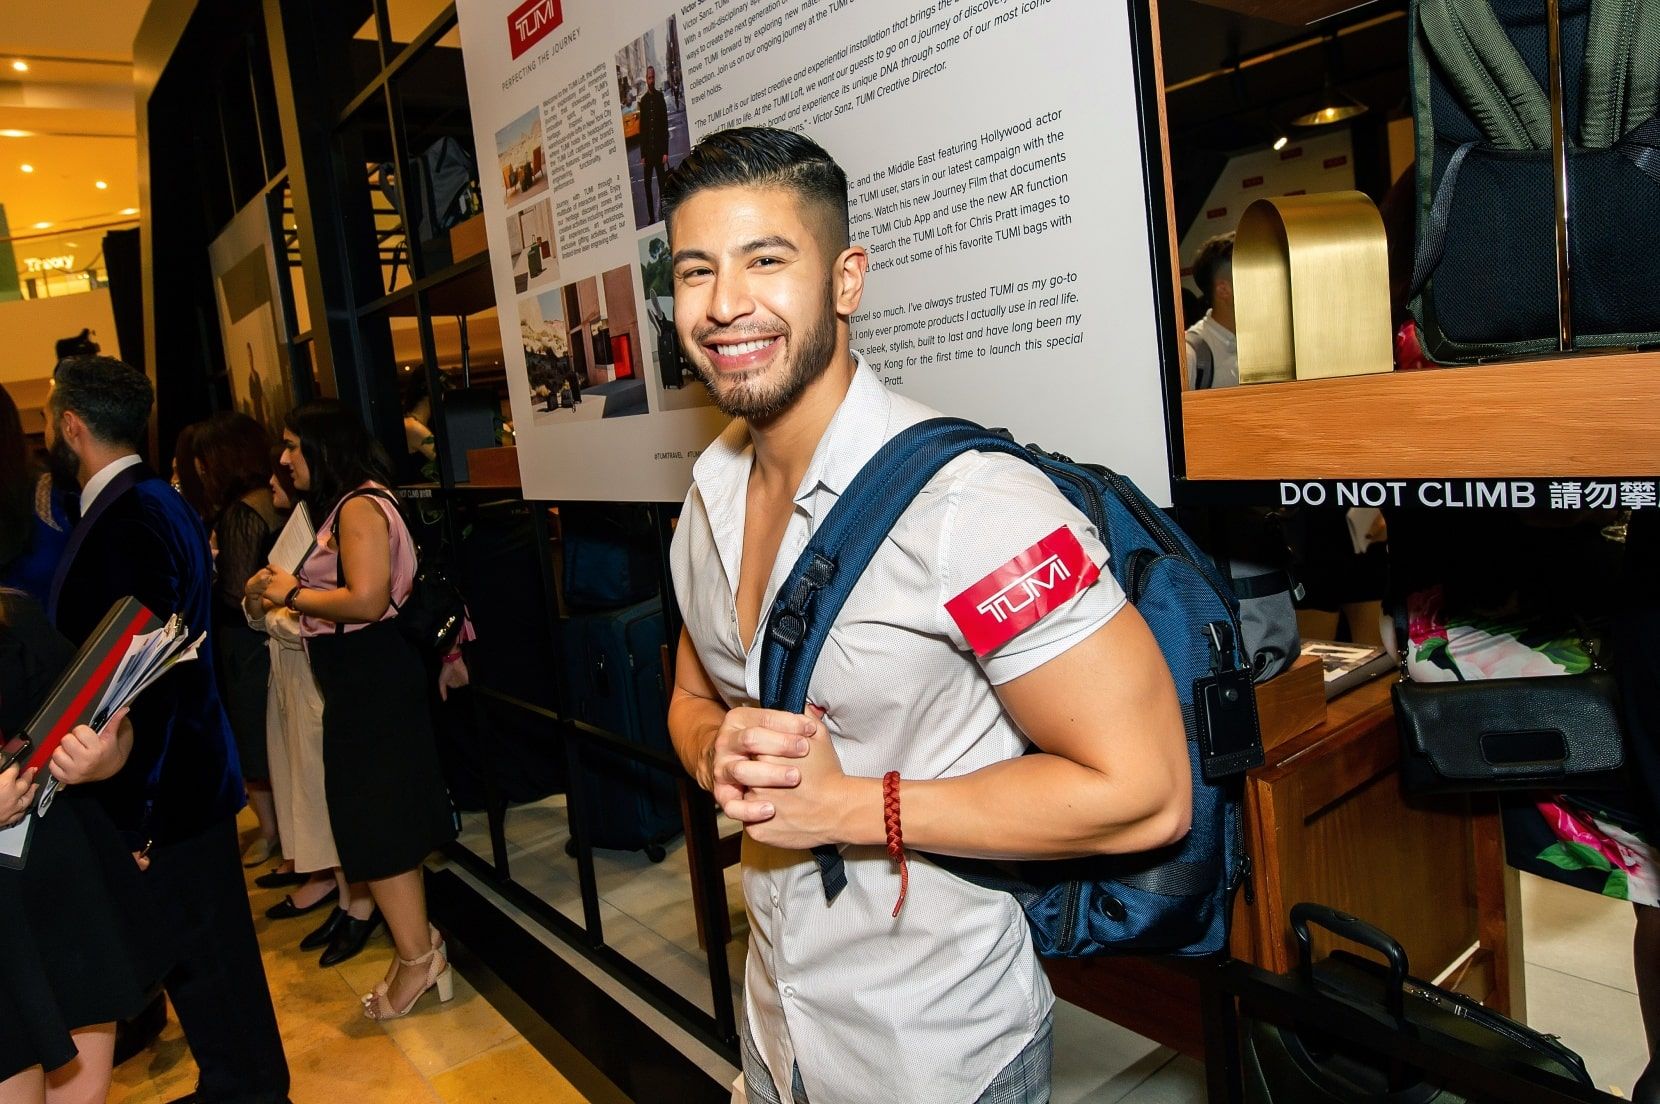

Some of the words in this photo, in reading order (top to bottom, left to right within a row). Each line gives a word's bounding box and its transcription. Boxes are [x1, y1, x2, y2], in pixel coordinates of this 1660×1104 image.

[515, 0, 554, 41] TUMI
[807, 45, 848, 74] experiential
[849, 27, 890, 54] installation
[891, 16, 908, 33] that
[909, 4, 936, 24] brings
[815, 9, 827, 21] the
[501, 60, 537, 91] PERFECTING
[538, 50, 550, 66] THE
[551, 26, 581, 56] JOURNEY
[801, 89, 839, 112] experience
[852, 72, 877, 89] unique
[879, 60, 898, 77] DNA
[900, 45, 933, 68] through
[935, 34, 960, 52] some
[974, 19, 991, 34] our
[993, 6, 1018, 26] most
[817, 71, 834, 87] want
[835, 66, 848, 78] our
[849, 54, 874, 74] guests
[875, 50, 884, 60] to
[885, 44, 896, 59] go
[898, 38, 908, 49] on
[916, 17, 951, 44] journey
[952, 9, 962, 23] of
[812, 109, 832, 124] Victor
[833, 101, 854, 115] Sanz,
[855, 89, 875, 106] TUMI
[876, 76, 910, 97] Creative
[911, 60, 947, 82] Director.
[856, 173, 870, 187] and
[872, 170, 885, 181] the
[887, 159, 915, 176] Middle
[917, 151, 935, 166] East
[937, 139, 977, 159] featuring
[980, 117, 1032, 145] Hollywood
[1035, 109, 1062, 126] actor
[858, 188, 879, 203] TUMI
[880, 184, 900, 197] user,
[900, 177, 920, 190] stars
[921, 173, 929, 184] in
[931, 169, 946, 181] our
[947, 159, 973, 175] latest
[974, 144, 1020, 167] campaign
[1022, 135, 1044, 151] with
[1046, 131, 1064, 144] the
[857, 229, 869, 239] the
[870, 221, 891, 235] TUMI
[893, 216, 911, 229] Club
[913, 212, 930, 225] App
[932, 204, 949, 219] and
[951, 202, 967, 213] use
[969, 196, 984, 208] the
[986, 190, 1007, 204] new
[1009, 183, 1024, 197] AR
[1026, 173, 1068, 192] function
[873, 201, 898, 217] Watch
[899, 198, 911, 209] his
[912, 193, 930, 205] new
[931, 182, 966, 200] Journey
[968, 173, 987, 189] Film
[989, 168, 1008, 182] that
[1009, 152, 1066, 176] documents
[869, 238, 896, 254] Search
[897, 236, 911, 247] the
[912, 227, 934, 242] TUMI
[936, 223, 953, 237] Loft
[954, 221, 967, 232] for
[969, 213, 993, 228] Chris
[994, 206, 1018, 221] Pratt
[1019, 197, 1056, 215] images
[1058, 194, 1070, 204] to
[871, 257, 894, 271] check
[895, 253, 909, 265] out
[910, 249, 932, 262] some
[934, 244, 943, 256] of
[944, 242, 957, 254] his
[958, 234, 993, 250] favorite
[994, 225, 1020, 241] TUMI
[1022, 221, 1047, 235] bags
[1049, 213, 1071, 228] with
[850, 310, 870, 324] travel
[872, 310, 881, 319] so
[883, 304, 906, 318] much.
[908, 302, 922, 312] I've
[924, 296, 953, 309] always
[955, 287, 986, 304] trusted
[989, 282, 1014, 297] TUMI
[1016, 282, 1028, 292] as
[1031, 278, 1047, 290] my
[1049, 271, 1077, 288] go-to
[858, 329, 874, 340] only
[892, 319, 926, 335] promote
[927, 312, 964, 329] products
[970, 304, 1006, 320] actually
[1008, 302, 1025, 313] use
[1027, 299, 1036, 310] in
[1038, 293, 1058, 308] real
[1060, 291, 1079, 304] life.
[866, 342, 888, 355] sleek,
[889, 338, 915, 352] stylish,
[917, 335, 935, 346] built
[936, 334, 945, 344] to
[947, 329, 964, 342] last
[965, 326, 983, 339] and
[985, 325, 1008, 336] have
[1011, 321, 1032, 333] long
[1035, 316, 1062, 328] been
[1065, 313, 1081, 326] my
[883, 359, 903, 369] Kong
[906, 355, 917, 366] for
[919, 353, 933, 364] the
[936, 351, 951, 362] first
[954, 347, 973, 360] time
[976, 346, 987, 357] to
[989, 340, 1020, 355] launch
[1024, 338, 1042, 350] this
[1046, 331, 1083, 349] special
[884, 376, 904, 386] Pratt.
[1280, 482, 1326, 506] DO
[1336, 482, 1406, 506] NOT
[1418, 481, 1536, 508] CLIMB
[1549, 481, 1660, 510] 請勿攀
[976, 553, 1071, 623] TUMI
